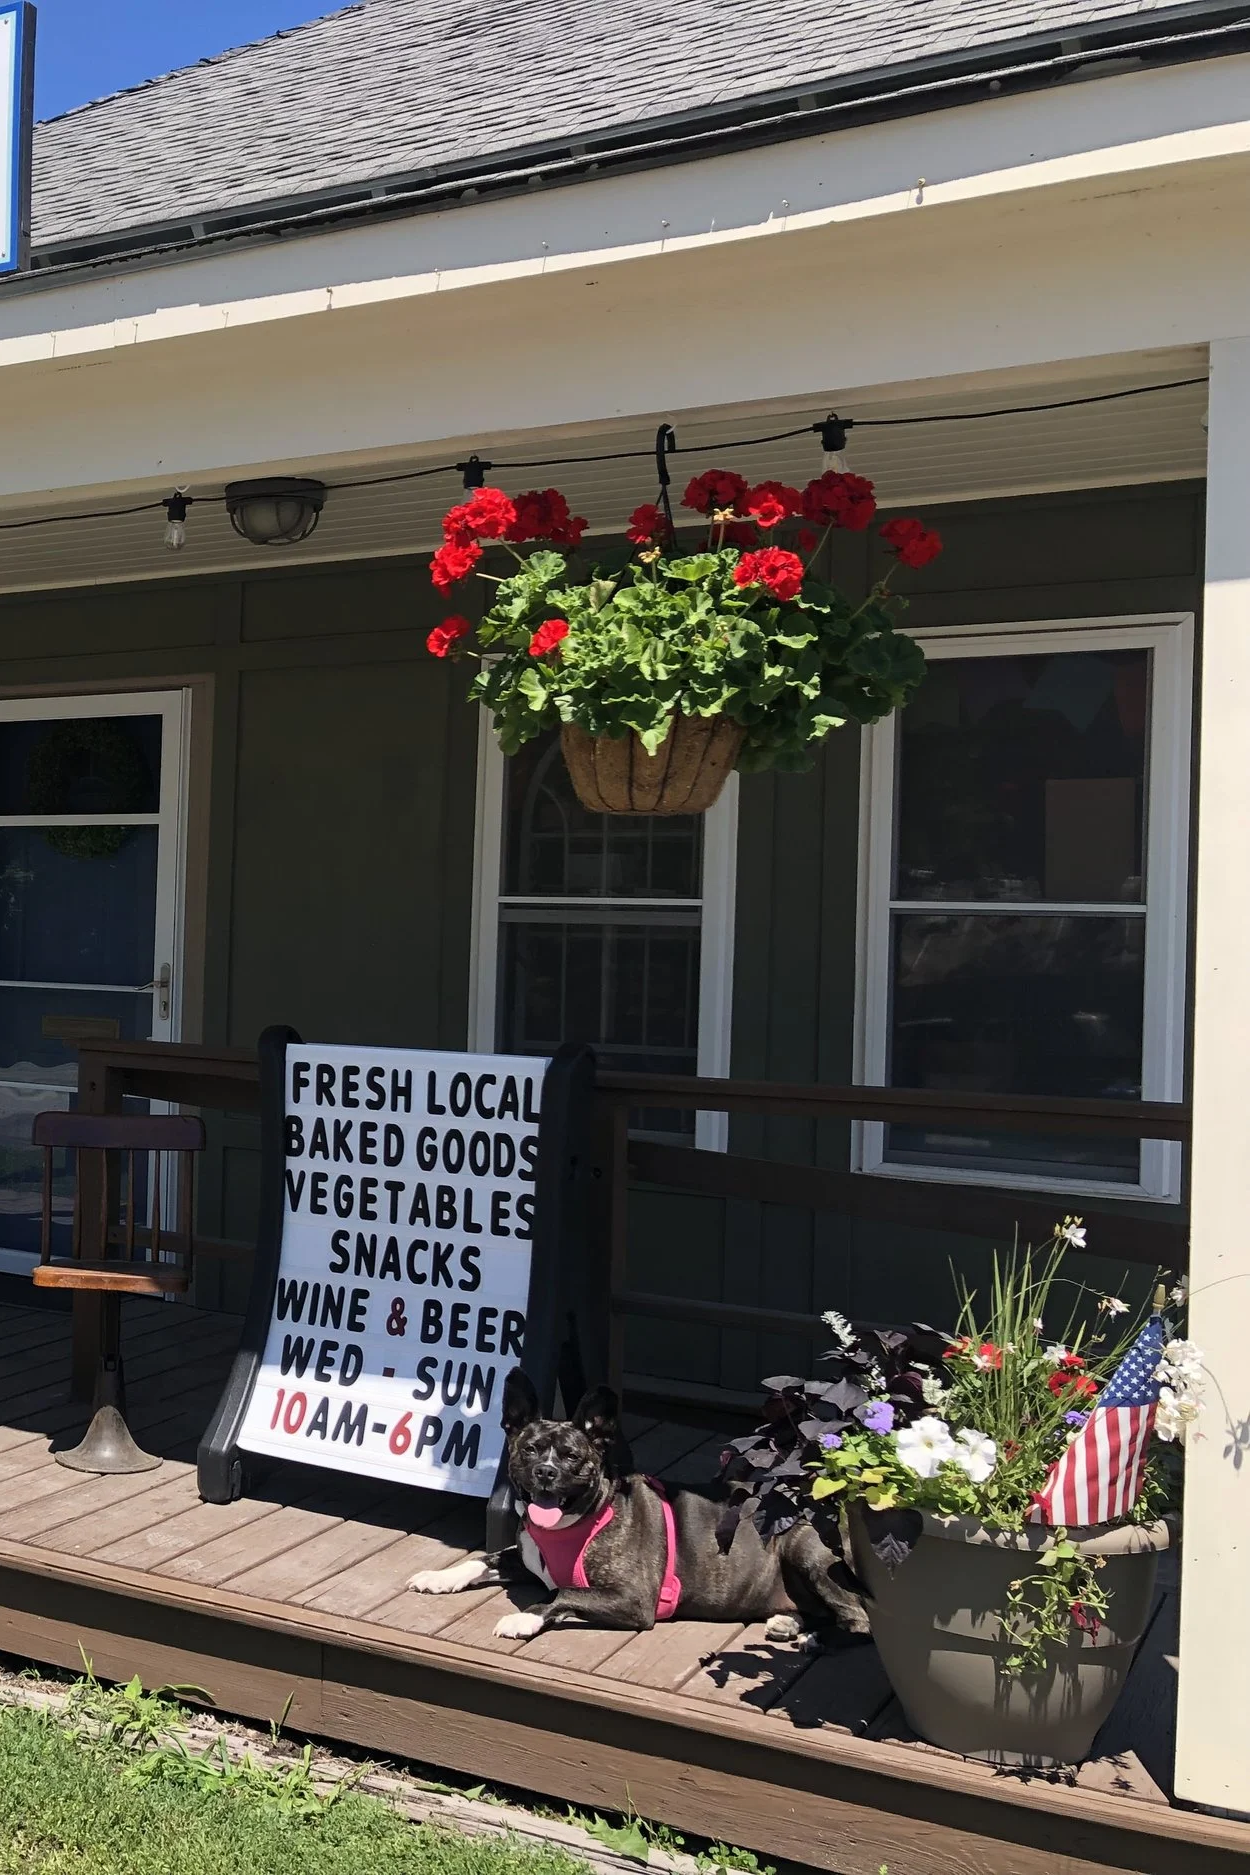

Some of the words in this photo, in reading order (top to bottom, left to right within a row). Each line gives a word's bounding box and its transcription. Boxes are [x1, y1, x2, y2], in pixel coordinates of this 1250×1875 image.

[292, 1061, 412, 1113] FRESH
[427, 1069, 540, 1123] LOCAL
[285, 1114, 405, 1168] BAKED
[416, 1126, 539, 1182] GOODS
[285, 1168, 535, 1241] VEGETABLES
[329, 1229, 482, 1292] SNACKS
[275, 1277, 371, 1333] WINE
[386, 1296, 407, 1337] &
[420, 1298, 526, 1359] BEER
[280, 1334, 364, 1387] WED
[412, 1356, 496, 1413] SUN
[269, 1387, 482, 1470] 10AM-6PM
